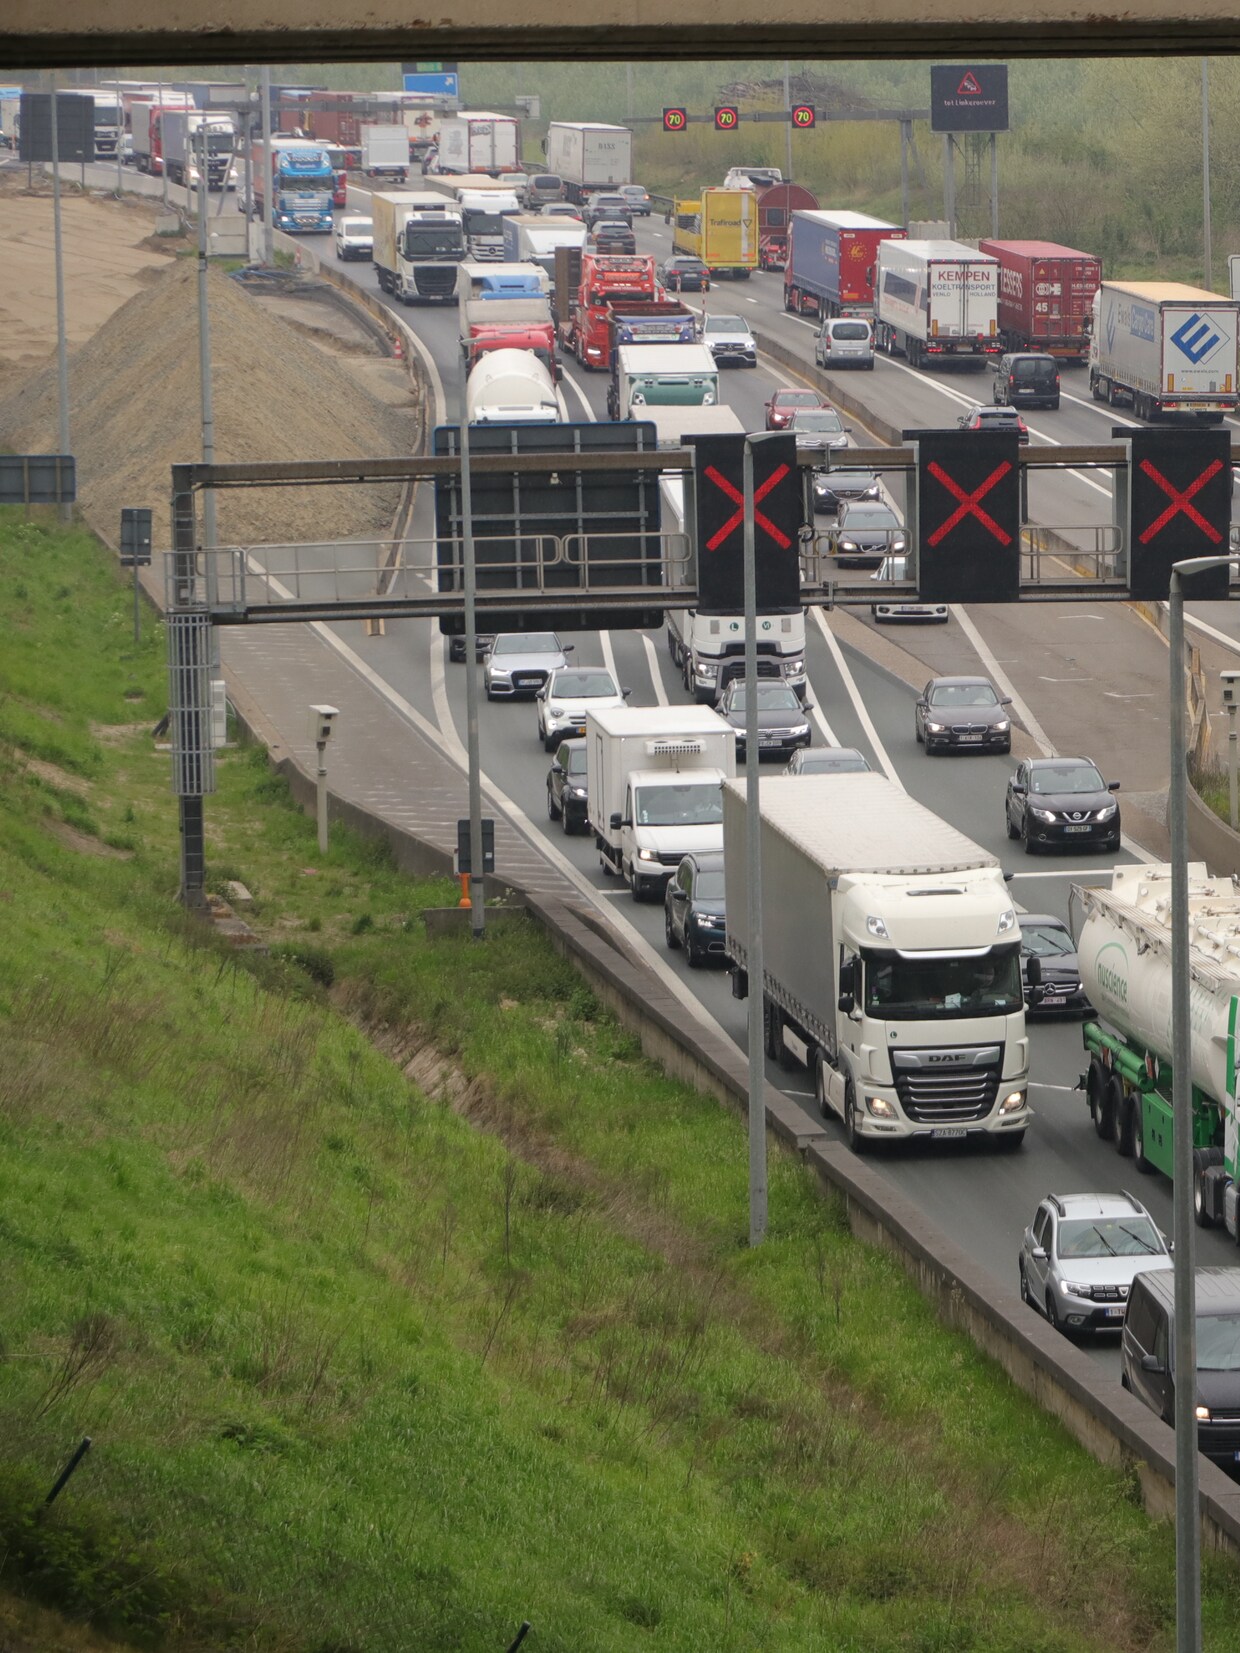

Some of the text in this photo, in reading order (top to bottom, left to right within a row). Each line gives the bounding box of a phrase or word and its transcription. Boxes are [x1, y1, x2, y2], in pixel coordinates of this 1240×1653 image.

[669, 114, 681, 125] 70
[720, 113, 732, 123] 70
[797, 111, 809, 122] 70
[709, 219, 741, 227] Trafiroad
[938, 271, 990, 282] KEMPEN
[932, 283, 996, 291] KOELTRANSPORT
[1035, 302, 1048, 312] 45
[928, 1054, 967, 1062] DAF
